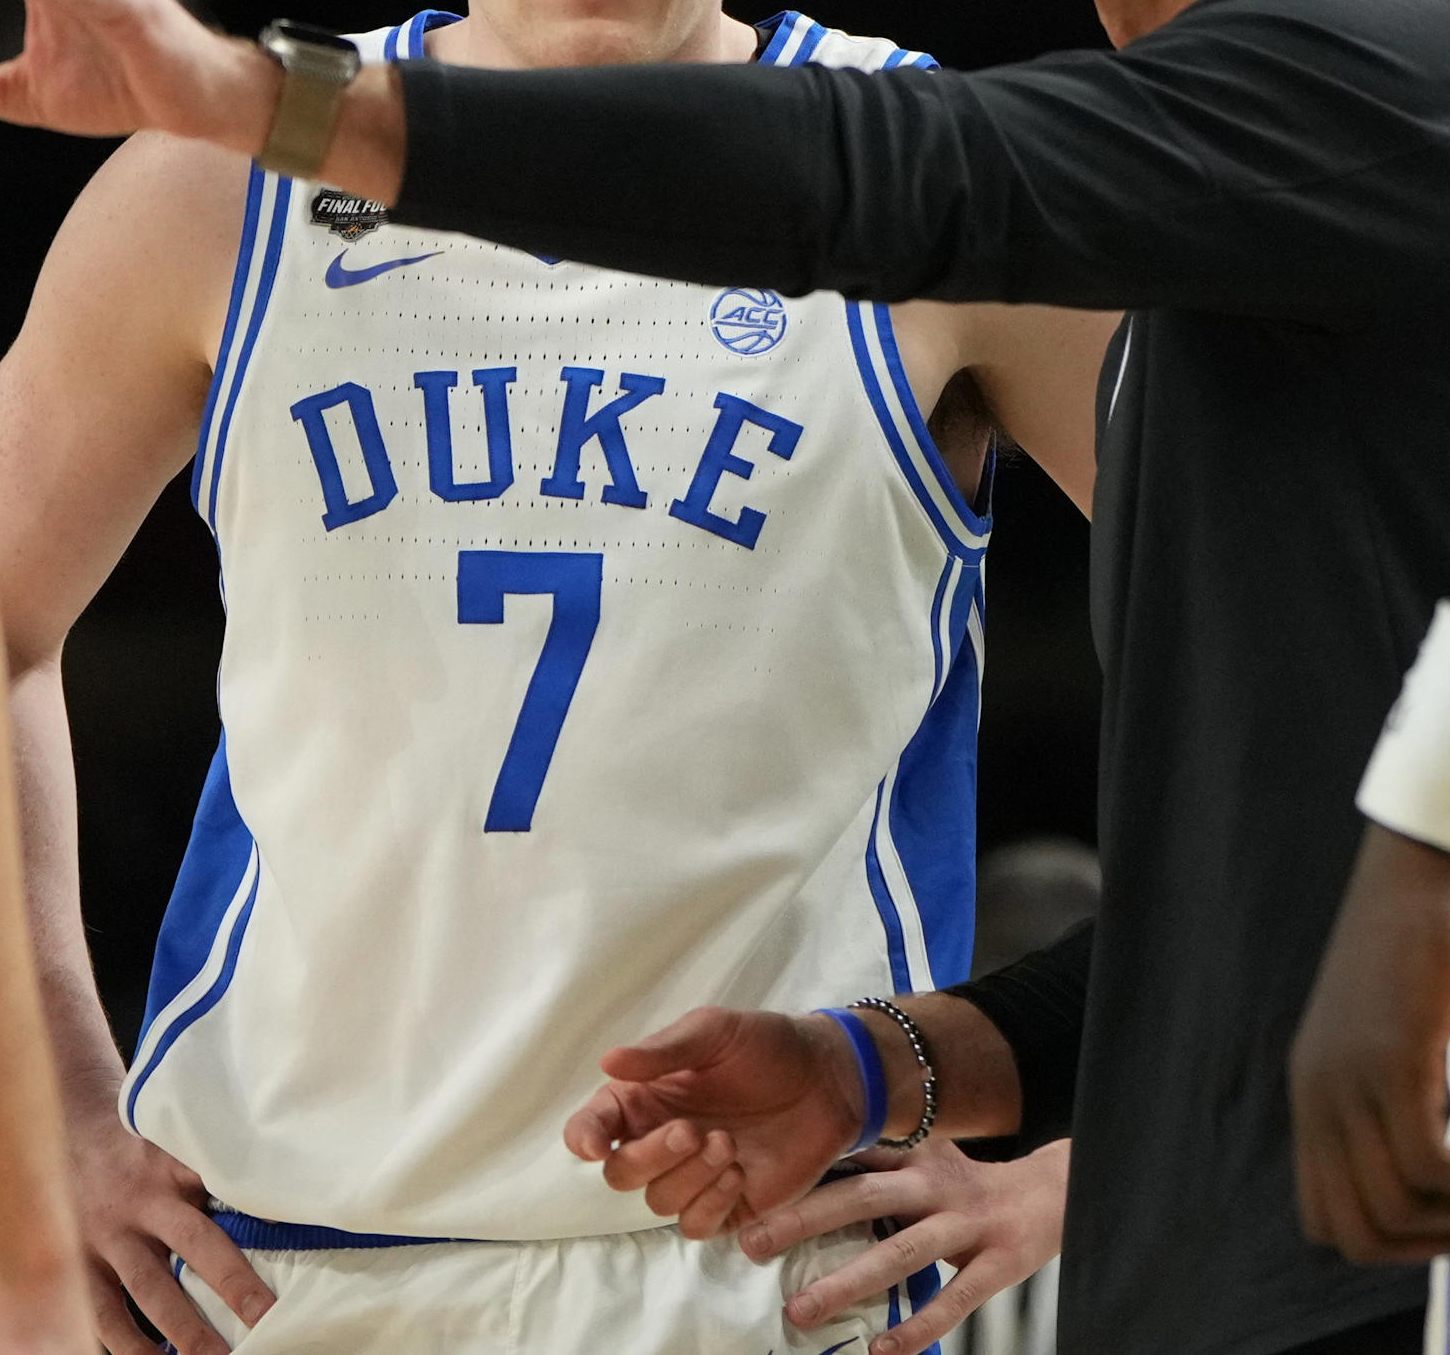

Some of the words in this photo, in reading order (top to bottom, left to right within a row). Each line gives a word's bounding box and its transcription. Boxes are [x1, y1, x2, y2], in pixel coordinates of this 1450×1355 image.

[317, 197, 361, 214] FINAL
[361, 199, 389, 213] FOU
[721, 306, 784, 326] ACC
[291, 366, 804, 549] DUKE
[457, 549, 605, 830] 7
